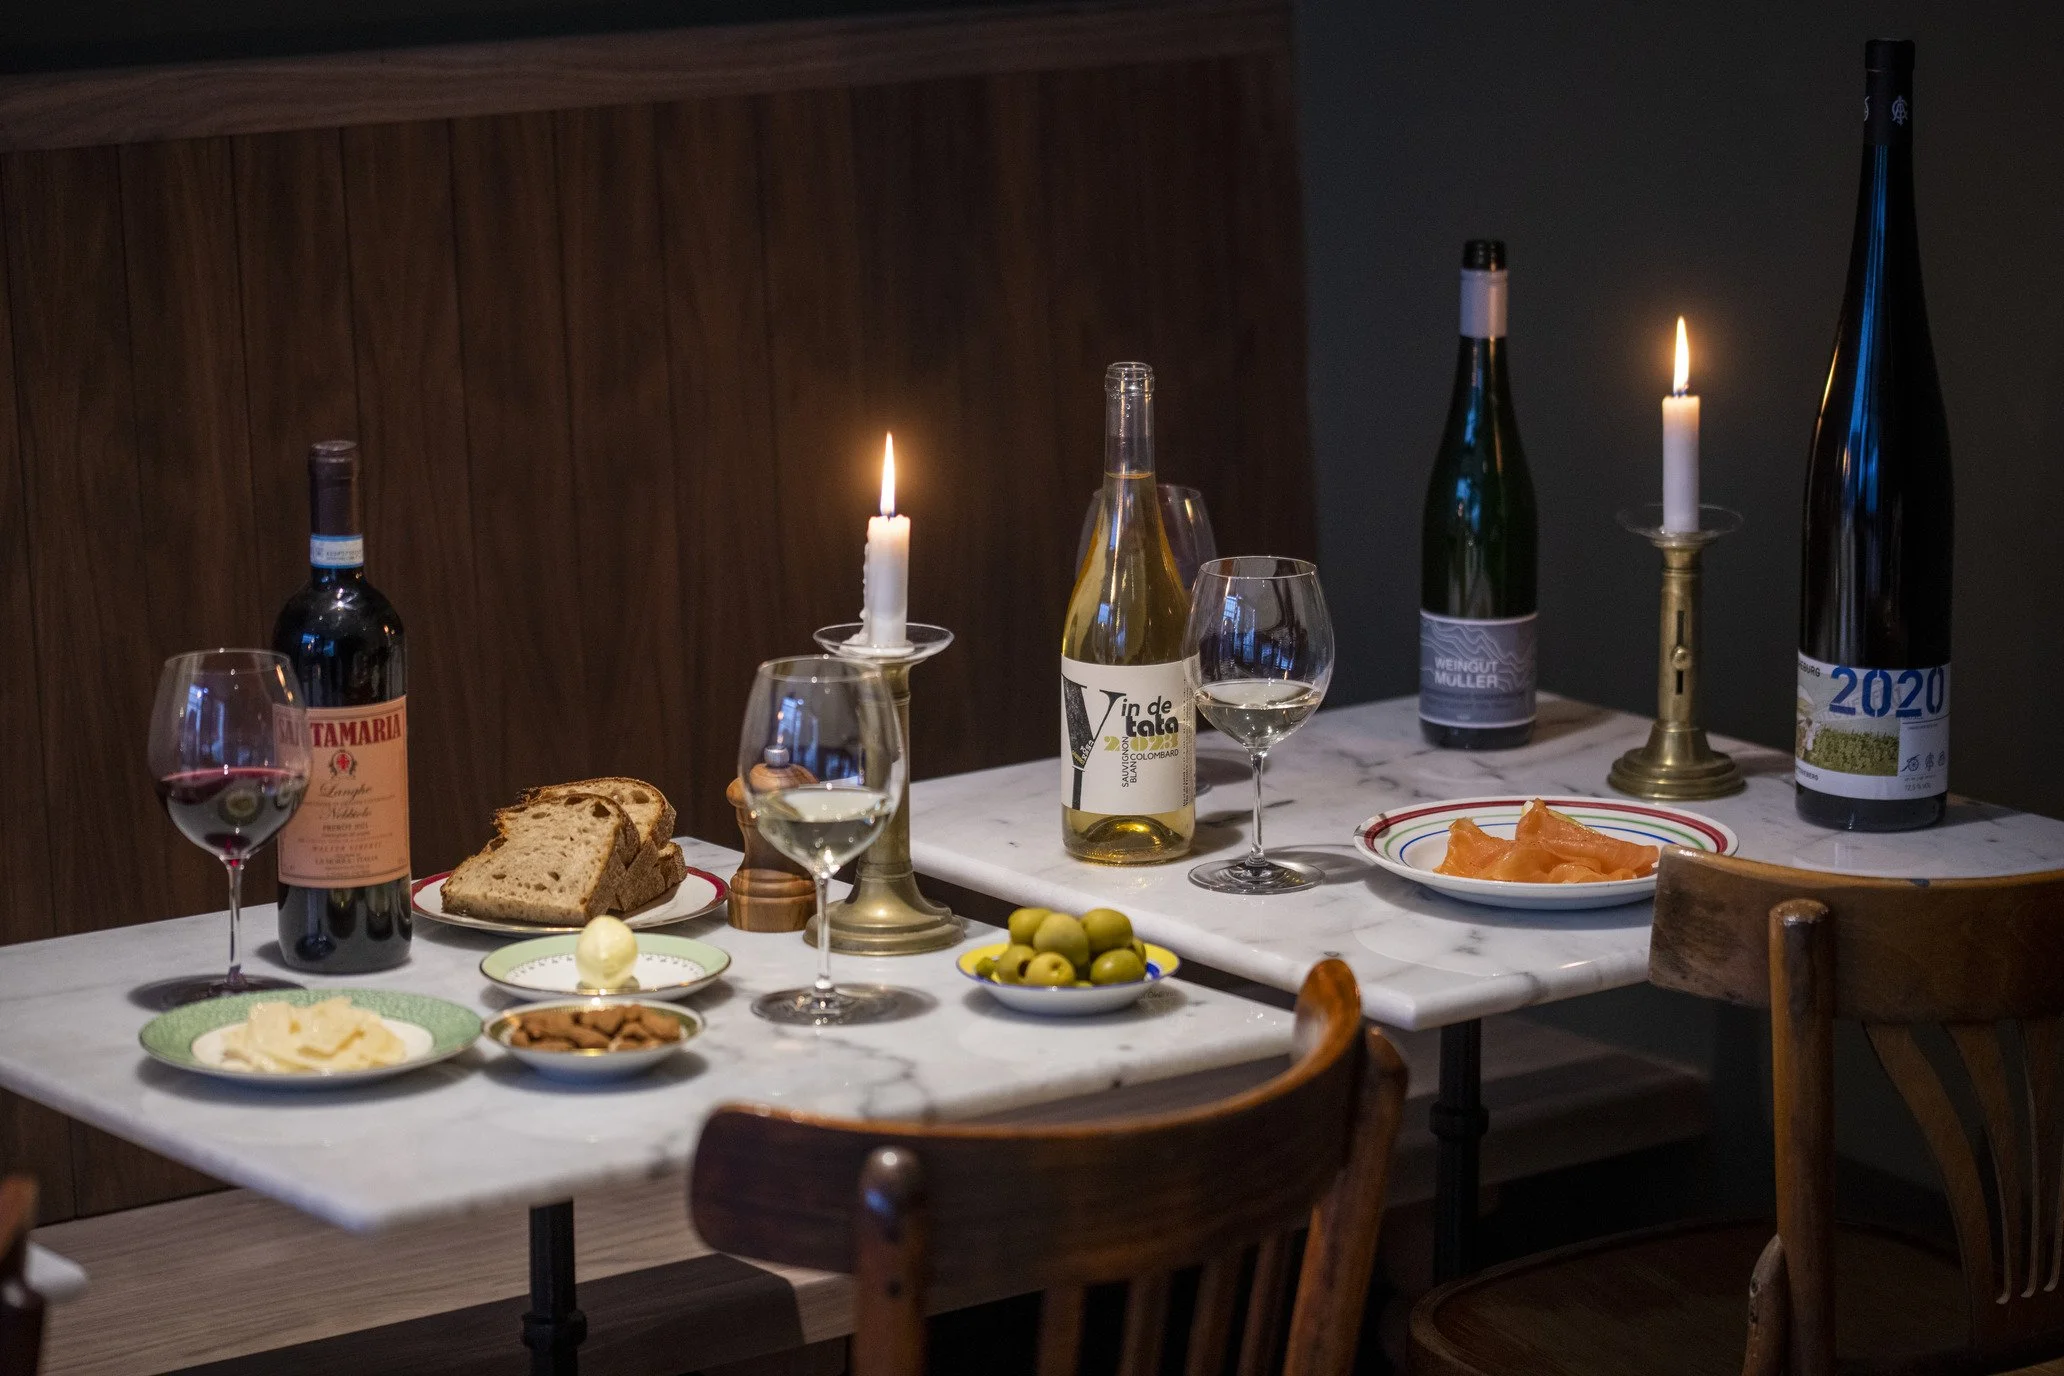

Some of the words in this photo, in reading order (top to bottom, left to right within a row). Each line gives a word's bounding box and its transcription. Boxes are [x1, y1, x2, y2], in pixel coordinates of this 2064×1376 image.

[1434, 656, 1498, 674] WEINGUT
[1829, 665, 1945, 718] 2020
[1147, 695, 1172, 715] de
[279, 714, 401, 748] SATAMARIA
[1125, 713, 1179, 737] tata
[1104, 733, 1179, 751] 2023
[1130, 748, 1179, 760] COLOMBARD
